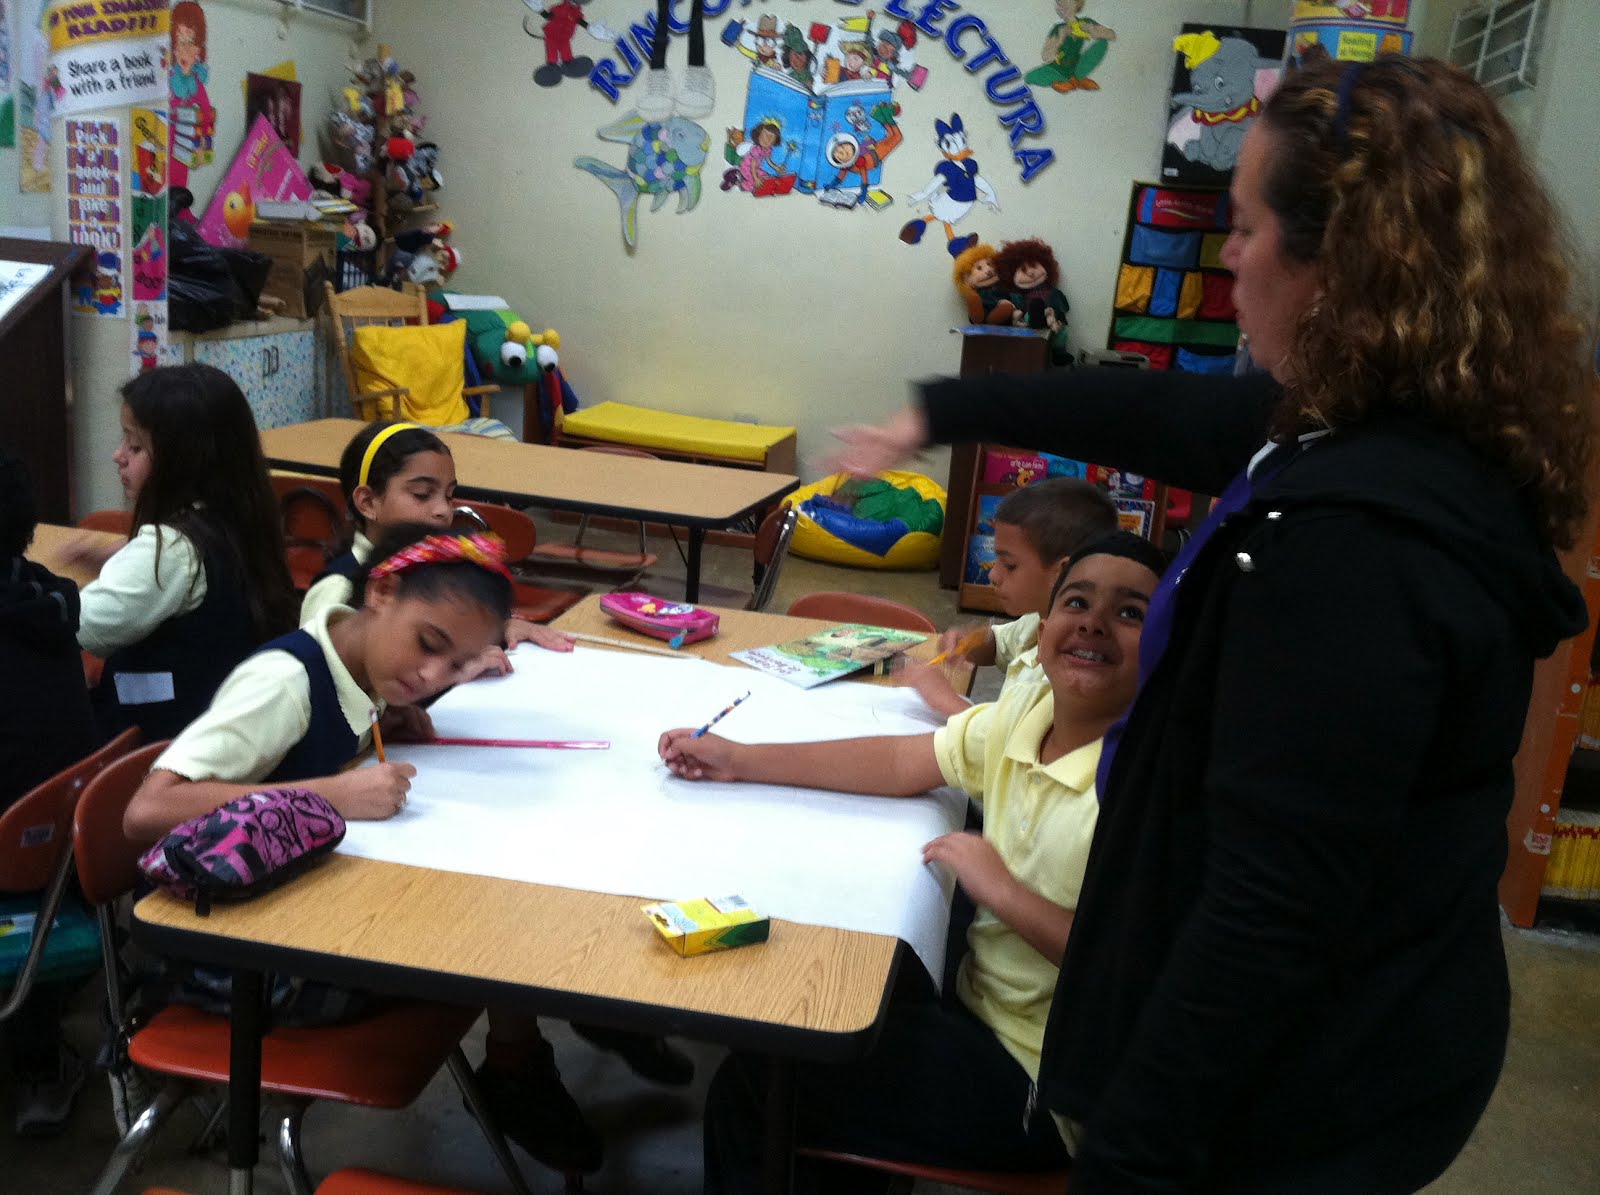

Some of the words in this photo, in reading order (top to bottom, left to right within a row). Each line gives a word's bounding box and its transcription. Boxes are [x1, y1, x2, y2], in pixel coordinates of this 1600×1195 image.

[67, 59, 107, 79] Share
[109, 58, 121, 73] a
[122, 49, 154, 71] book
[69, 75, 104, 97] with
[105, 78, 118, 92] a
[119, 68, 157, 90] friend
[884, 0, 1055, 183] LECTURA
[75, 129, 110, 145] Pick
[75, 164, 111, 180] book
[79, 181, 107, 195] and
